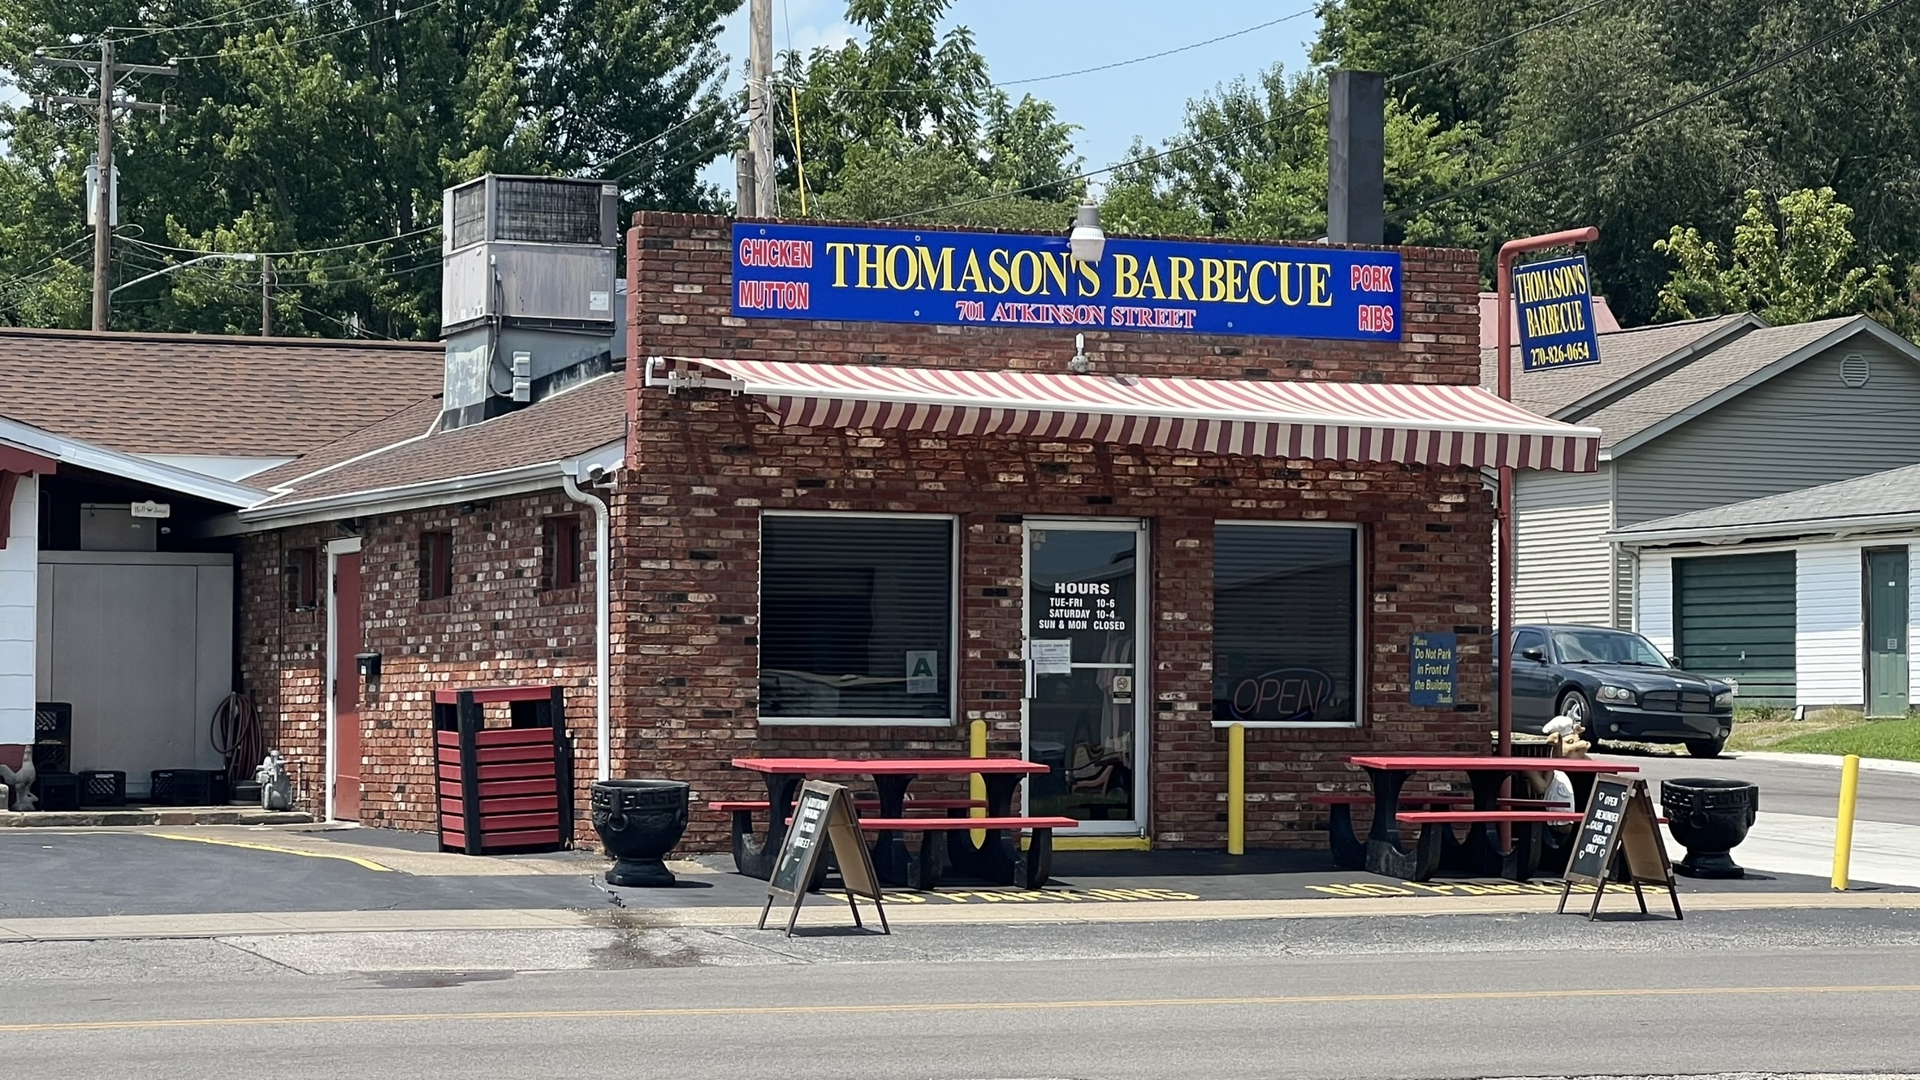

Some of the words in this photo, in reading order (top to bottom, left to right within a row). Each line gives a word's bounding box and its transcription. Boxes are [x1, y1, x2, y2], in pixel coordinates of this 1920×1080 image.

[739, 237, 813, 269] CHICKEN
[826, 243, 1101, 297] THOMASON'S
[1113, 253, 1333, 307] BARBECUE
[1351, 264, 1394, 293] PORK
[1516, 264, 1587, 304] THOMASON'S
[739, 280, 810, 311] MUTTON
[956, 301, 986, 322] 701
[991, 301, 1106, 326] ATKINSON
[1111, 306, 1197, 329] STREET
[1358, 304, 1394, 333] RIBS
[1525, 300, 1586, 338] BARBECUE
[1530, 341, 1590, 367] 270-826-0654
[1054, 582, 1111, 595] HOURS
[1049, 597, 1083, 608] TUE-FRI
[1096, 598, 1116, 608] 10-6
[1049, 609, 1091, 619] SATURDAY
[1096, 609, 1116, 620] 10-4
[1038, 619, 1056, 630] SUN
[1058, 620, 1065, 630] &
[1068, 620, 1088, 630] MON
[1093, 620, 1126, 631] CLOSED
[912, 657, 934, 677] A
[1415, 648, 1425, 659] Do
[1425, 648, 1437, 660] Not
[1437, 648, 1452, 660] Park
[1417, 664, 1424, 675] in
[1424, 663, 1442, 675] Front
[1442, 664, 1450, 675] of
[1234, 678, 1323, 714] OPEN
[1414, 680, 1425, 690] the
[1425, 679, 1452, 693] Building
